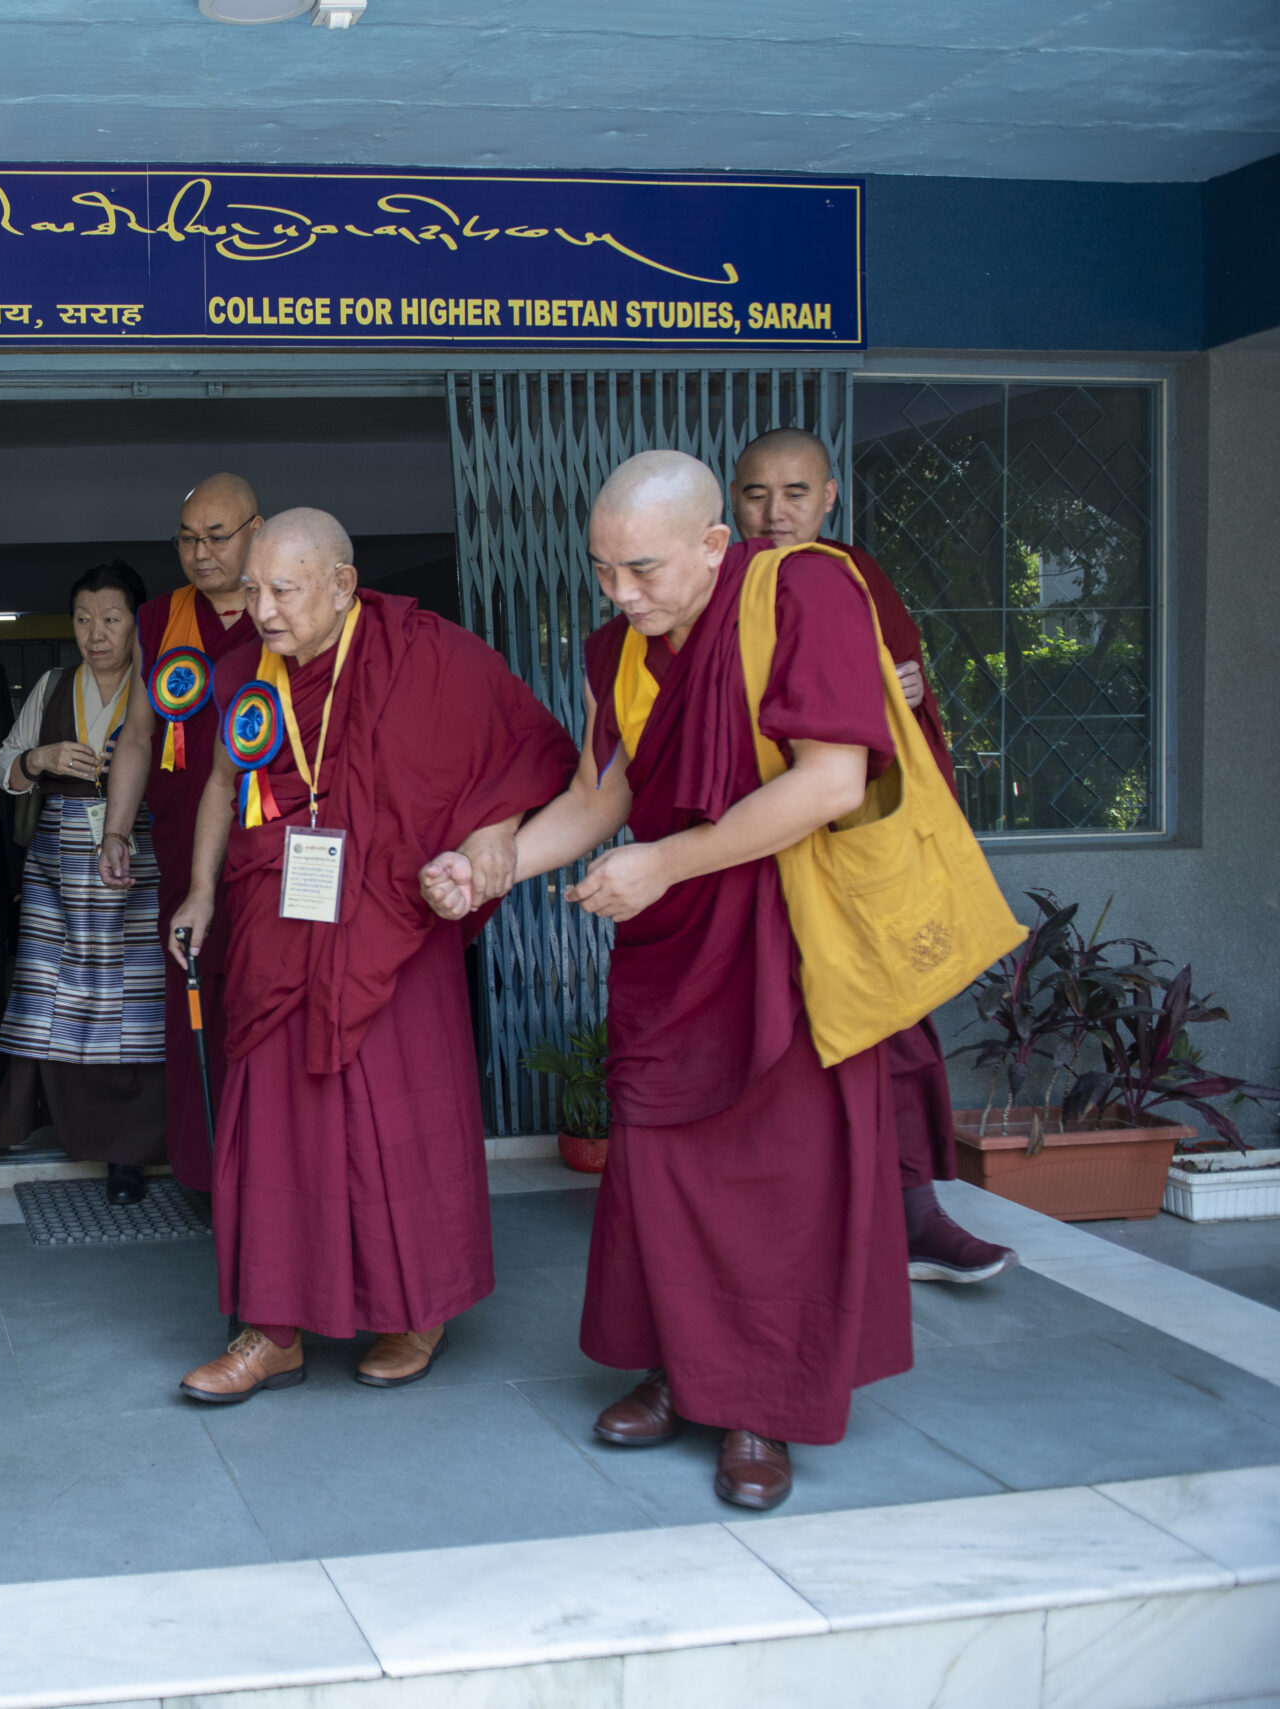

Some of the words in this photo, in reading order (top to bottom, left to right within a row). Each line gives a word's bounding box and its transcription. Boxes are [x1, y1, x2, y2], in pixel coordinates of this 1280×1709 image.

[55, 303, 145, 326] सराह
[208, 296, 331, 325] COLLEGE
[339, 297, 393, 325] FOR
[400, 297, 501, 326] HIGHER
[507, 299, 618, 327] TIBETAN
[625, 300, 741, 334] STUDIES,
[748, 302, 832, 330] SARAH
